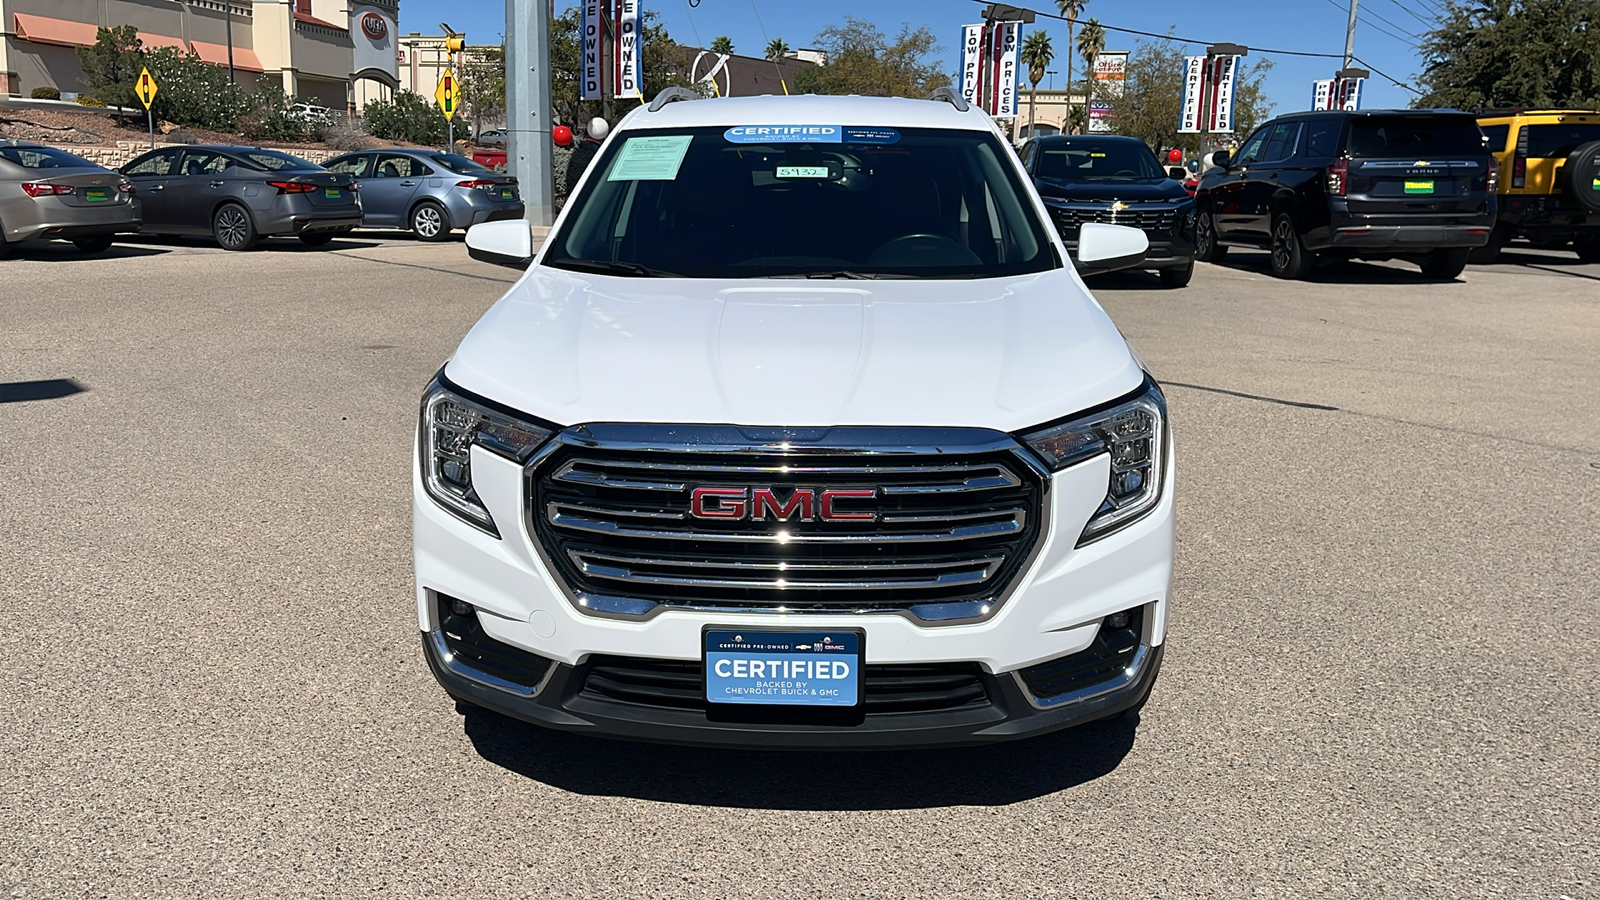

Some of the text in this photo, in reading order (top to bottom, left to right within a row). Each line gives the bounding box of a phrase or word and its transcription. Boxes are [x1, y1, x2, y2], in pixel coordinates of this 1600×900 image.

[586, 25, 597, 91] OWNED
[622, 22, 634, 89] OWNED
[967, 29, 977, 54] LOW
[1001, 27, 1015, 113] LOW PRICES
[1185, 60, 1198, 128] CERTIFIED
[1219, 60, 1232, 128] CERTIFIED
[731, 127, 836, 135] CERTIFIED
[780, 168, 822, 176] 5932
[690, 487, 877, 522] GMC
[714, 659, 850, 679] CERTIFIED
[724, 687, 778, 695] CHEVROLET
